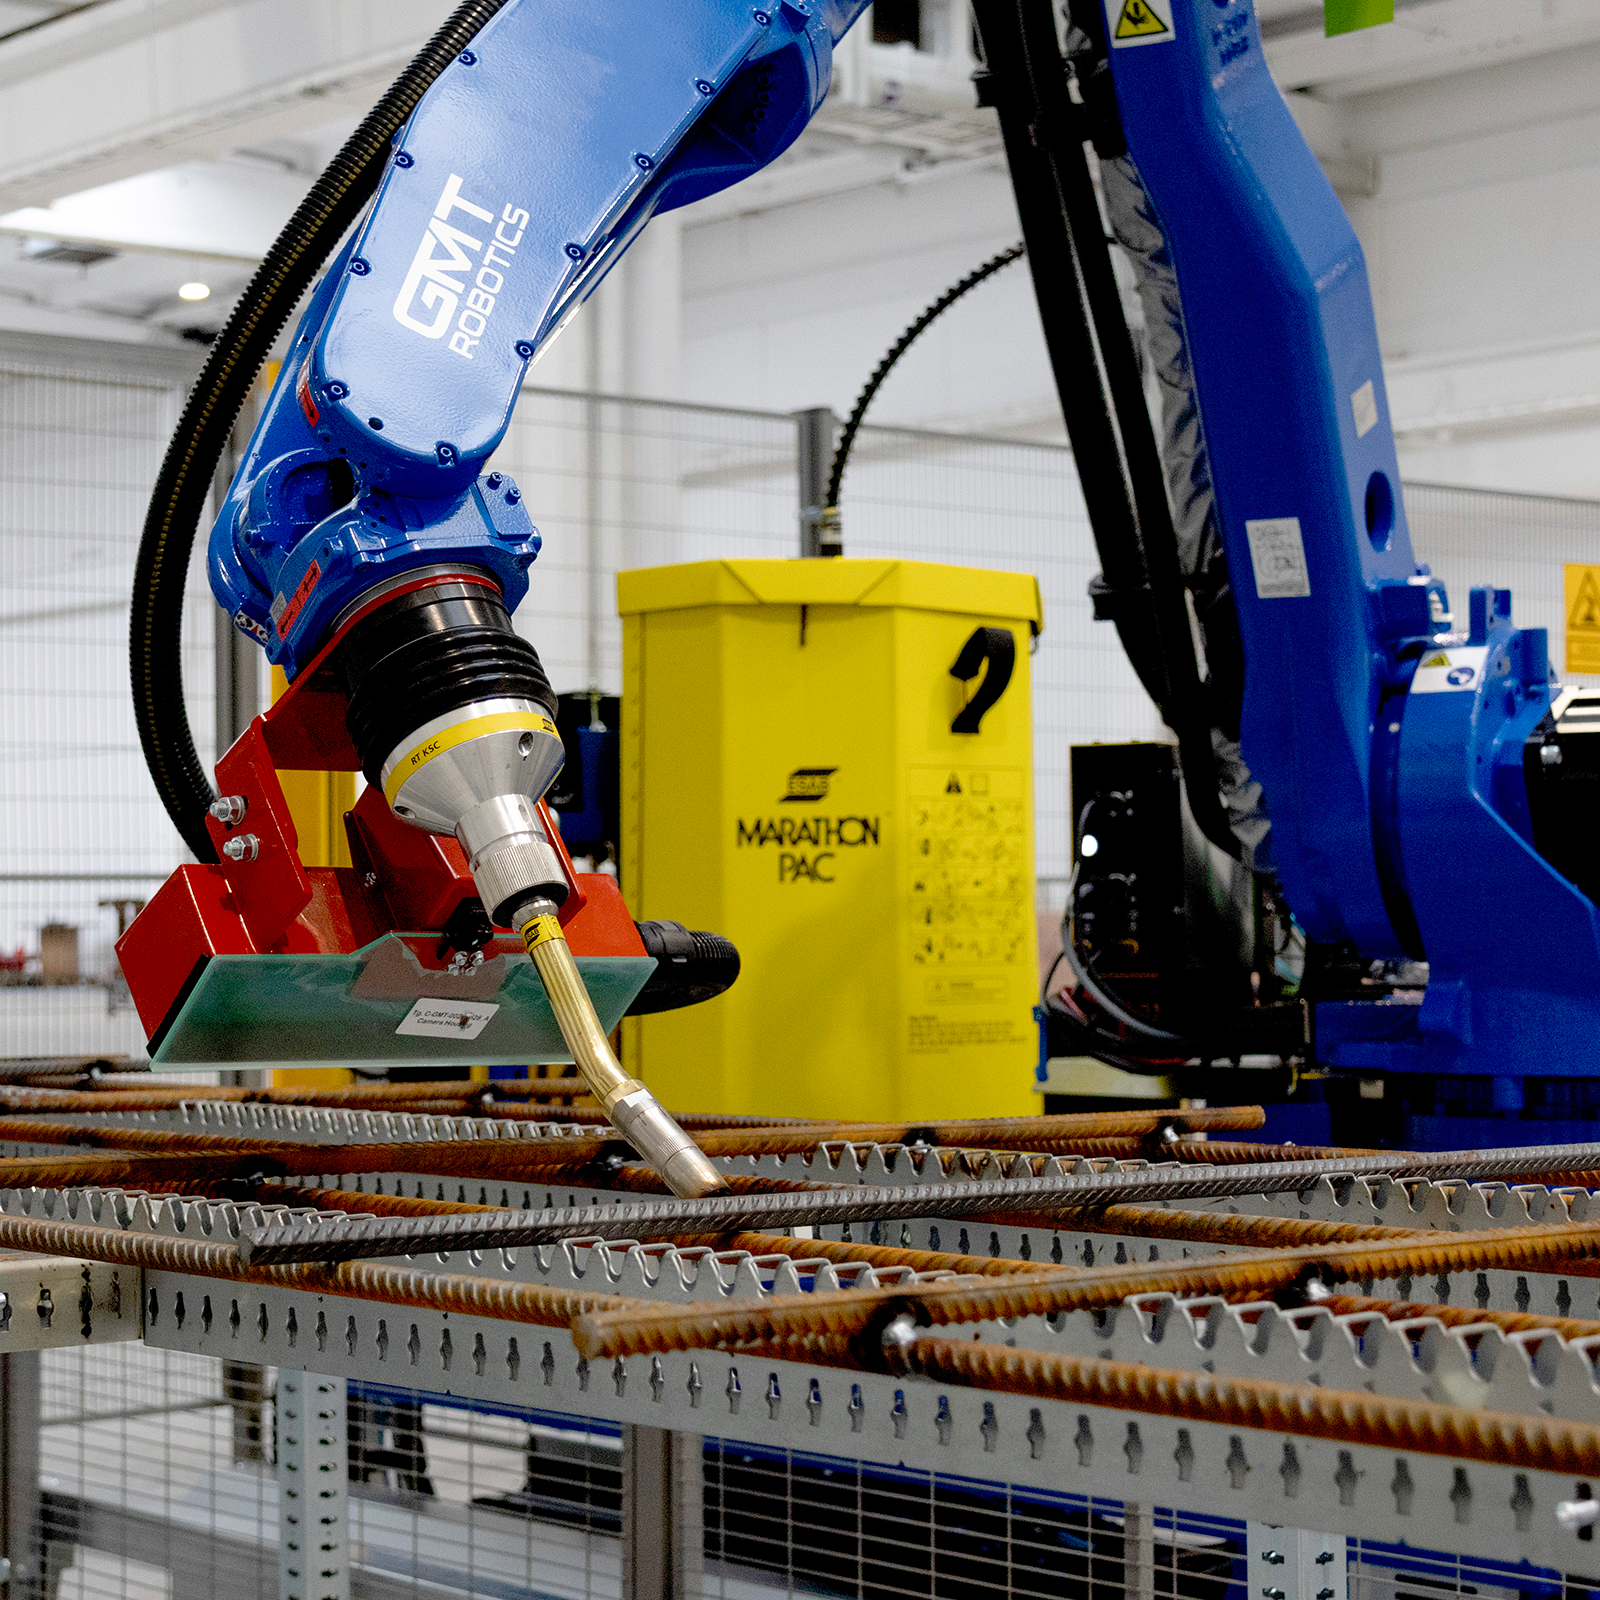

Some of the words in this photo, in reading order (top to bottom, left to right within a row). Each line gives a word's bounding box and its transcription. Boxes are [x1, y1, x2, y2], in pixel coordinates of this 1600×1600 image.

[392, 173, 495, 339] GMT
[448, 203, 530, 360] ROBOTICS
[410, 752, 421, 765] RT
[422, 740, 441, 757] KSC
[737, 817, 879, 847] MARATHON
[778, 853, 836, 882] PAC
[417, 1018, 443, 1026] Camera
